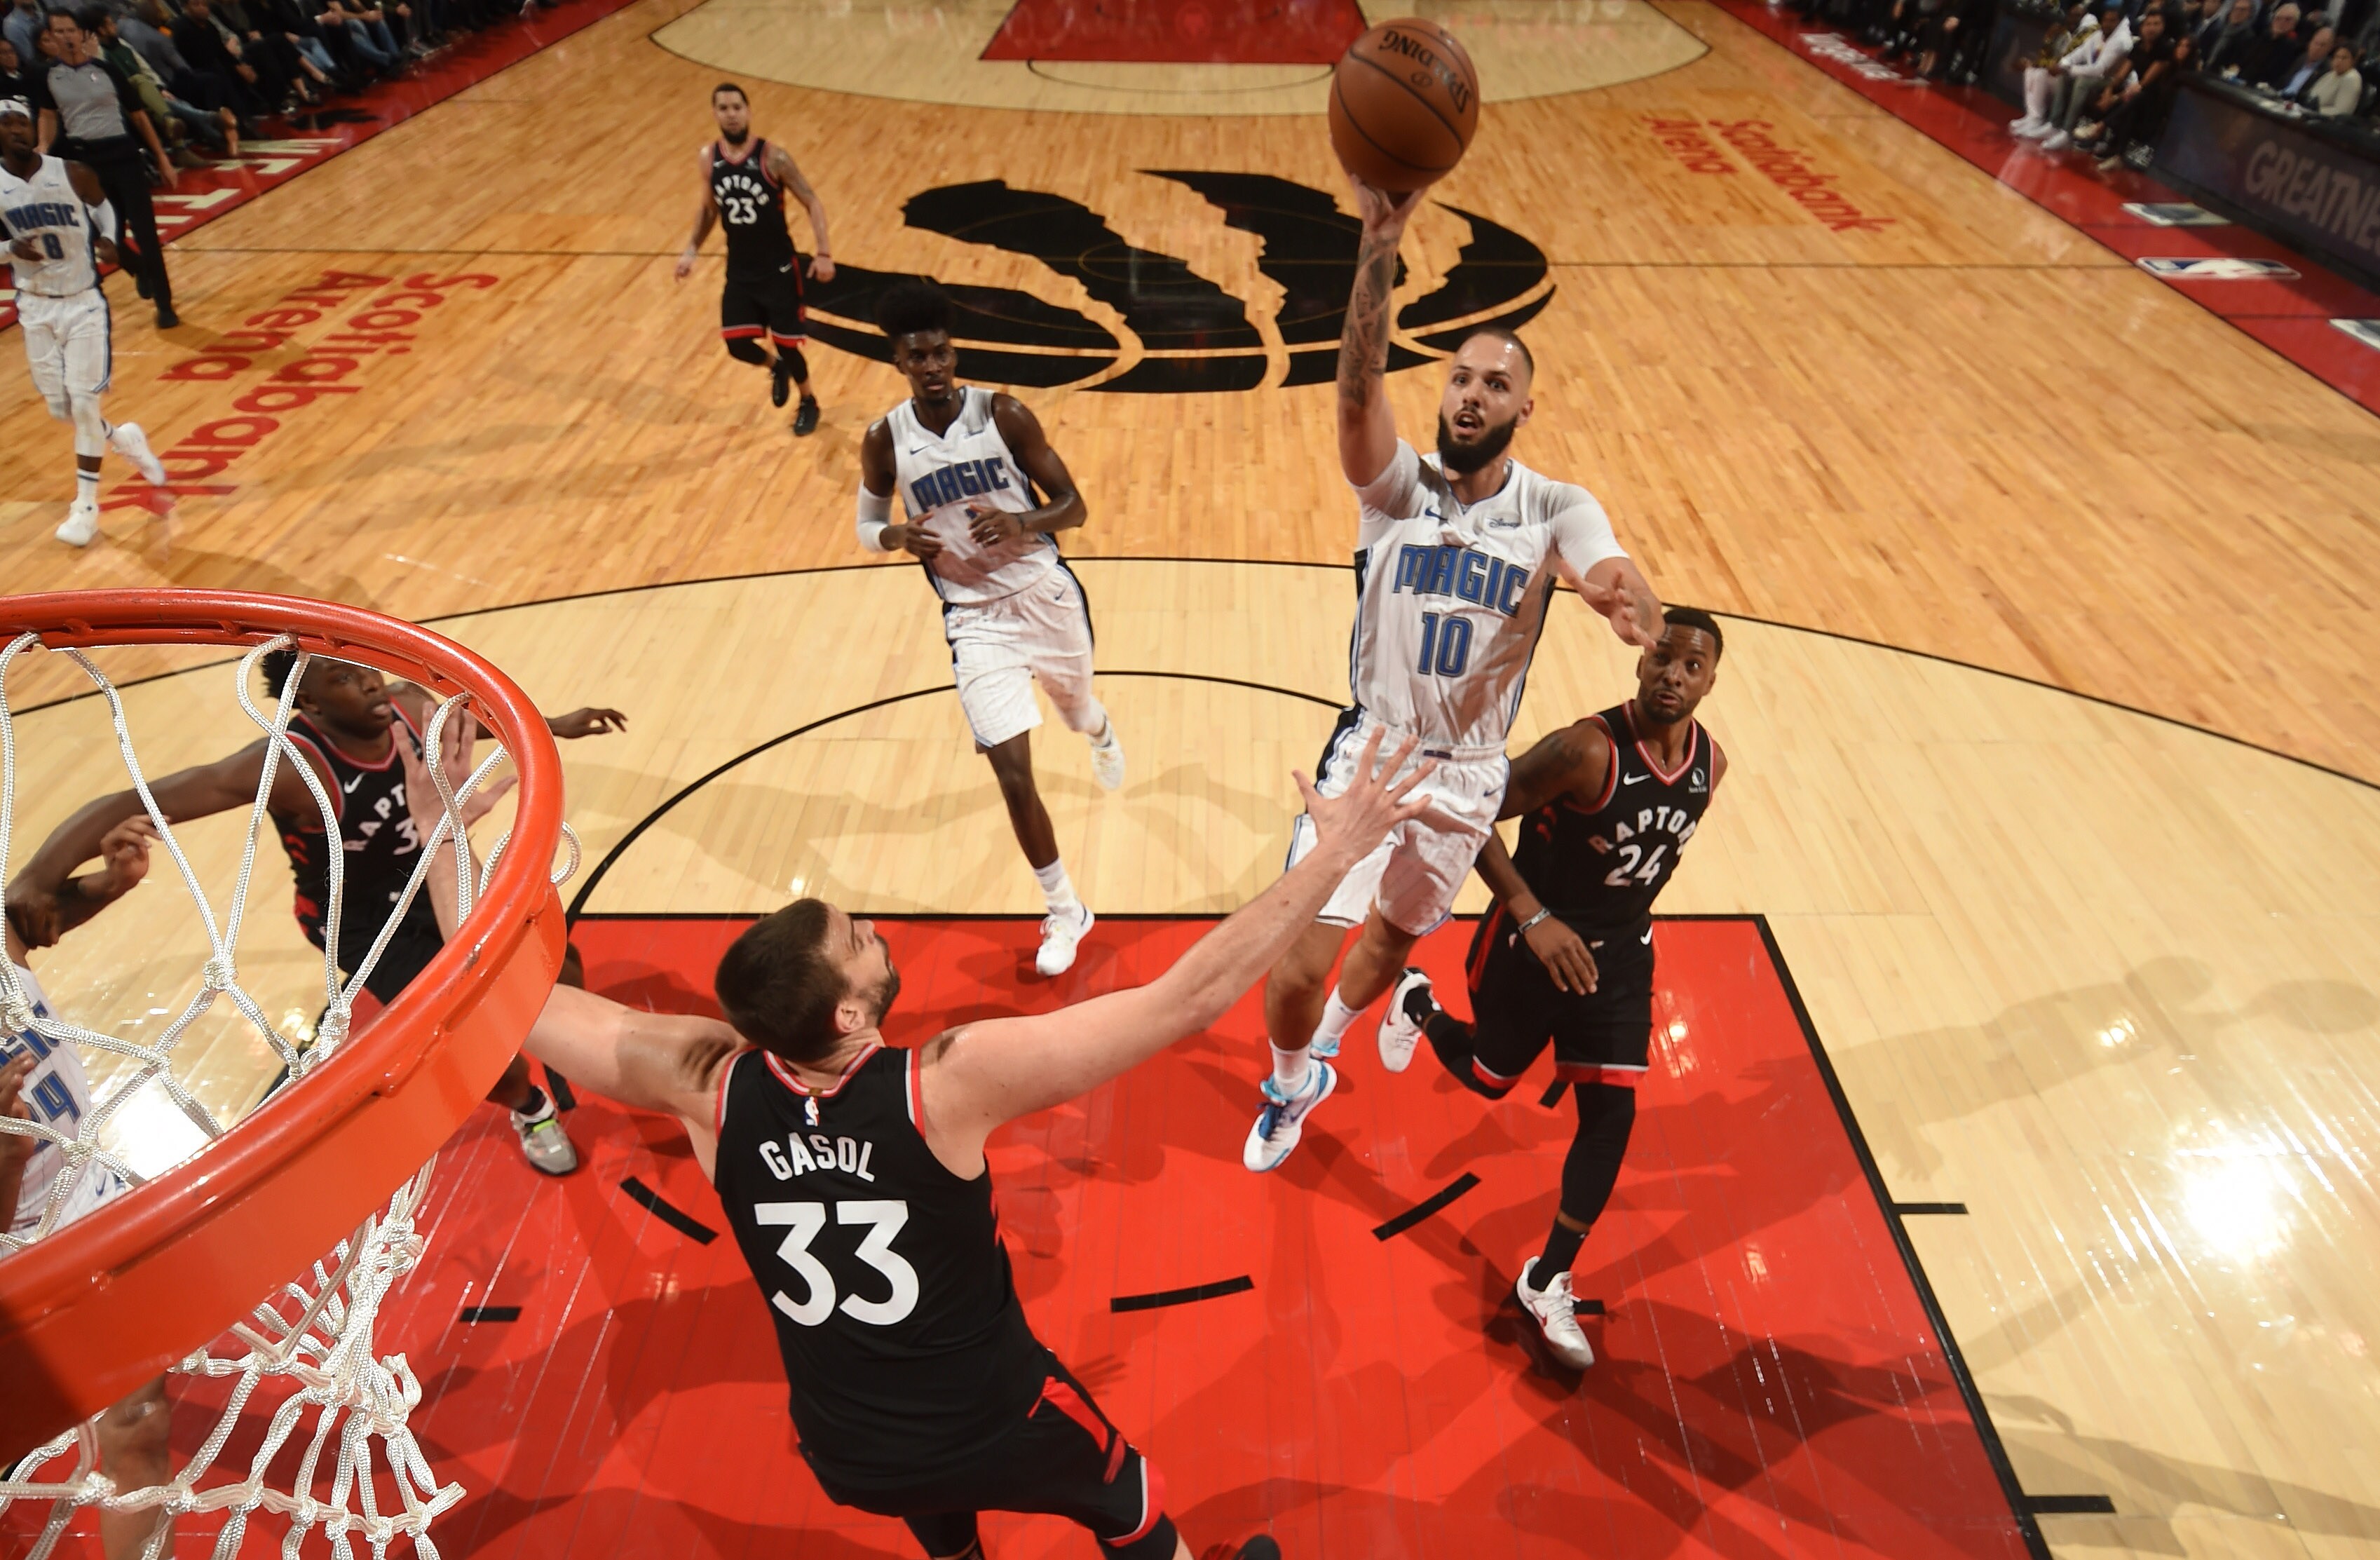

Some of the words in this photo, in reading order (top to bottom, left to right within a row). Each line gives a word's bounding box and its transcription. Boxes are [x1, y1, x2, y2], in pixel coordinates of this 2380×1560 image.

[1378, 29, 1472, 114] SPALDING
[5, 202, 79, 233] MAGIC
[725, 197, 758, 224] 23
[42, 233, 64, 260] 8
[156, 271, 394, 381] Arena
[98, 273, 498, 515] Scotiabank
[910, 457, 1010, 513] MAGIC
[1392, 543, 1530, 618] MAGIC
[1417, 611, 1474, 677] 10
[393, 817, 419, 855] 3
[1603, 844, 1668, 886] 24
[759, 1132, 876, 1183] GASOL
[754, 1200, 920, 1327] 33
